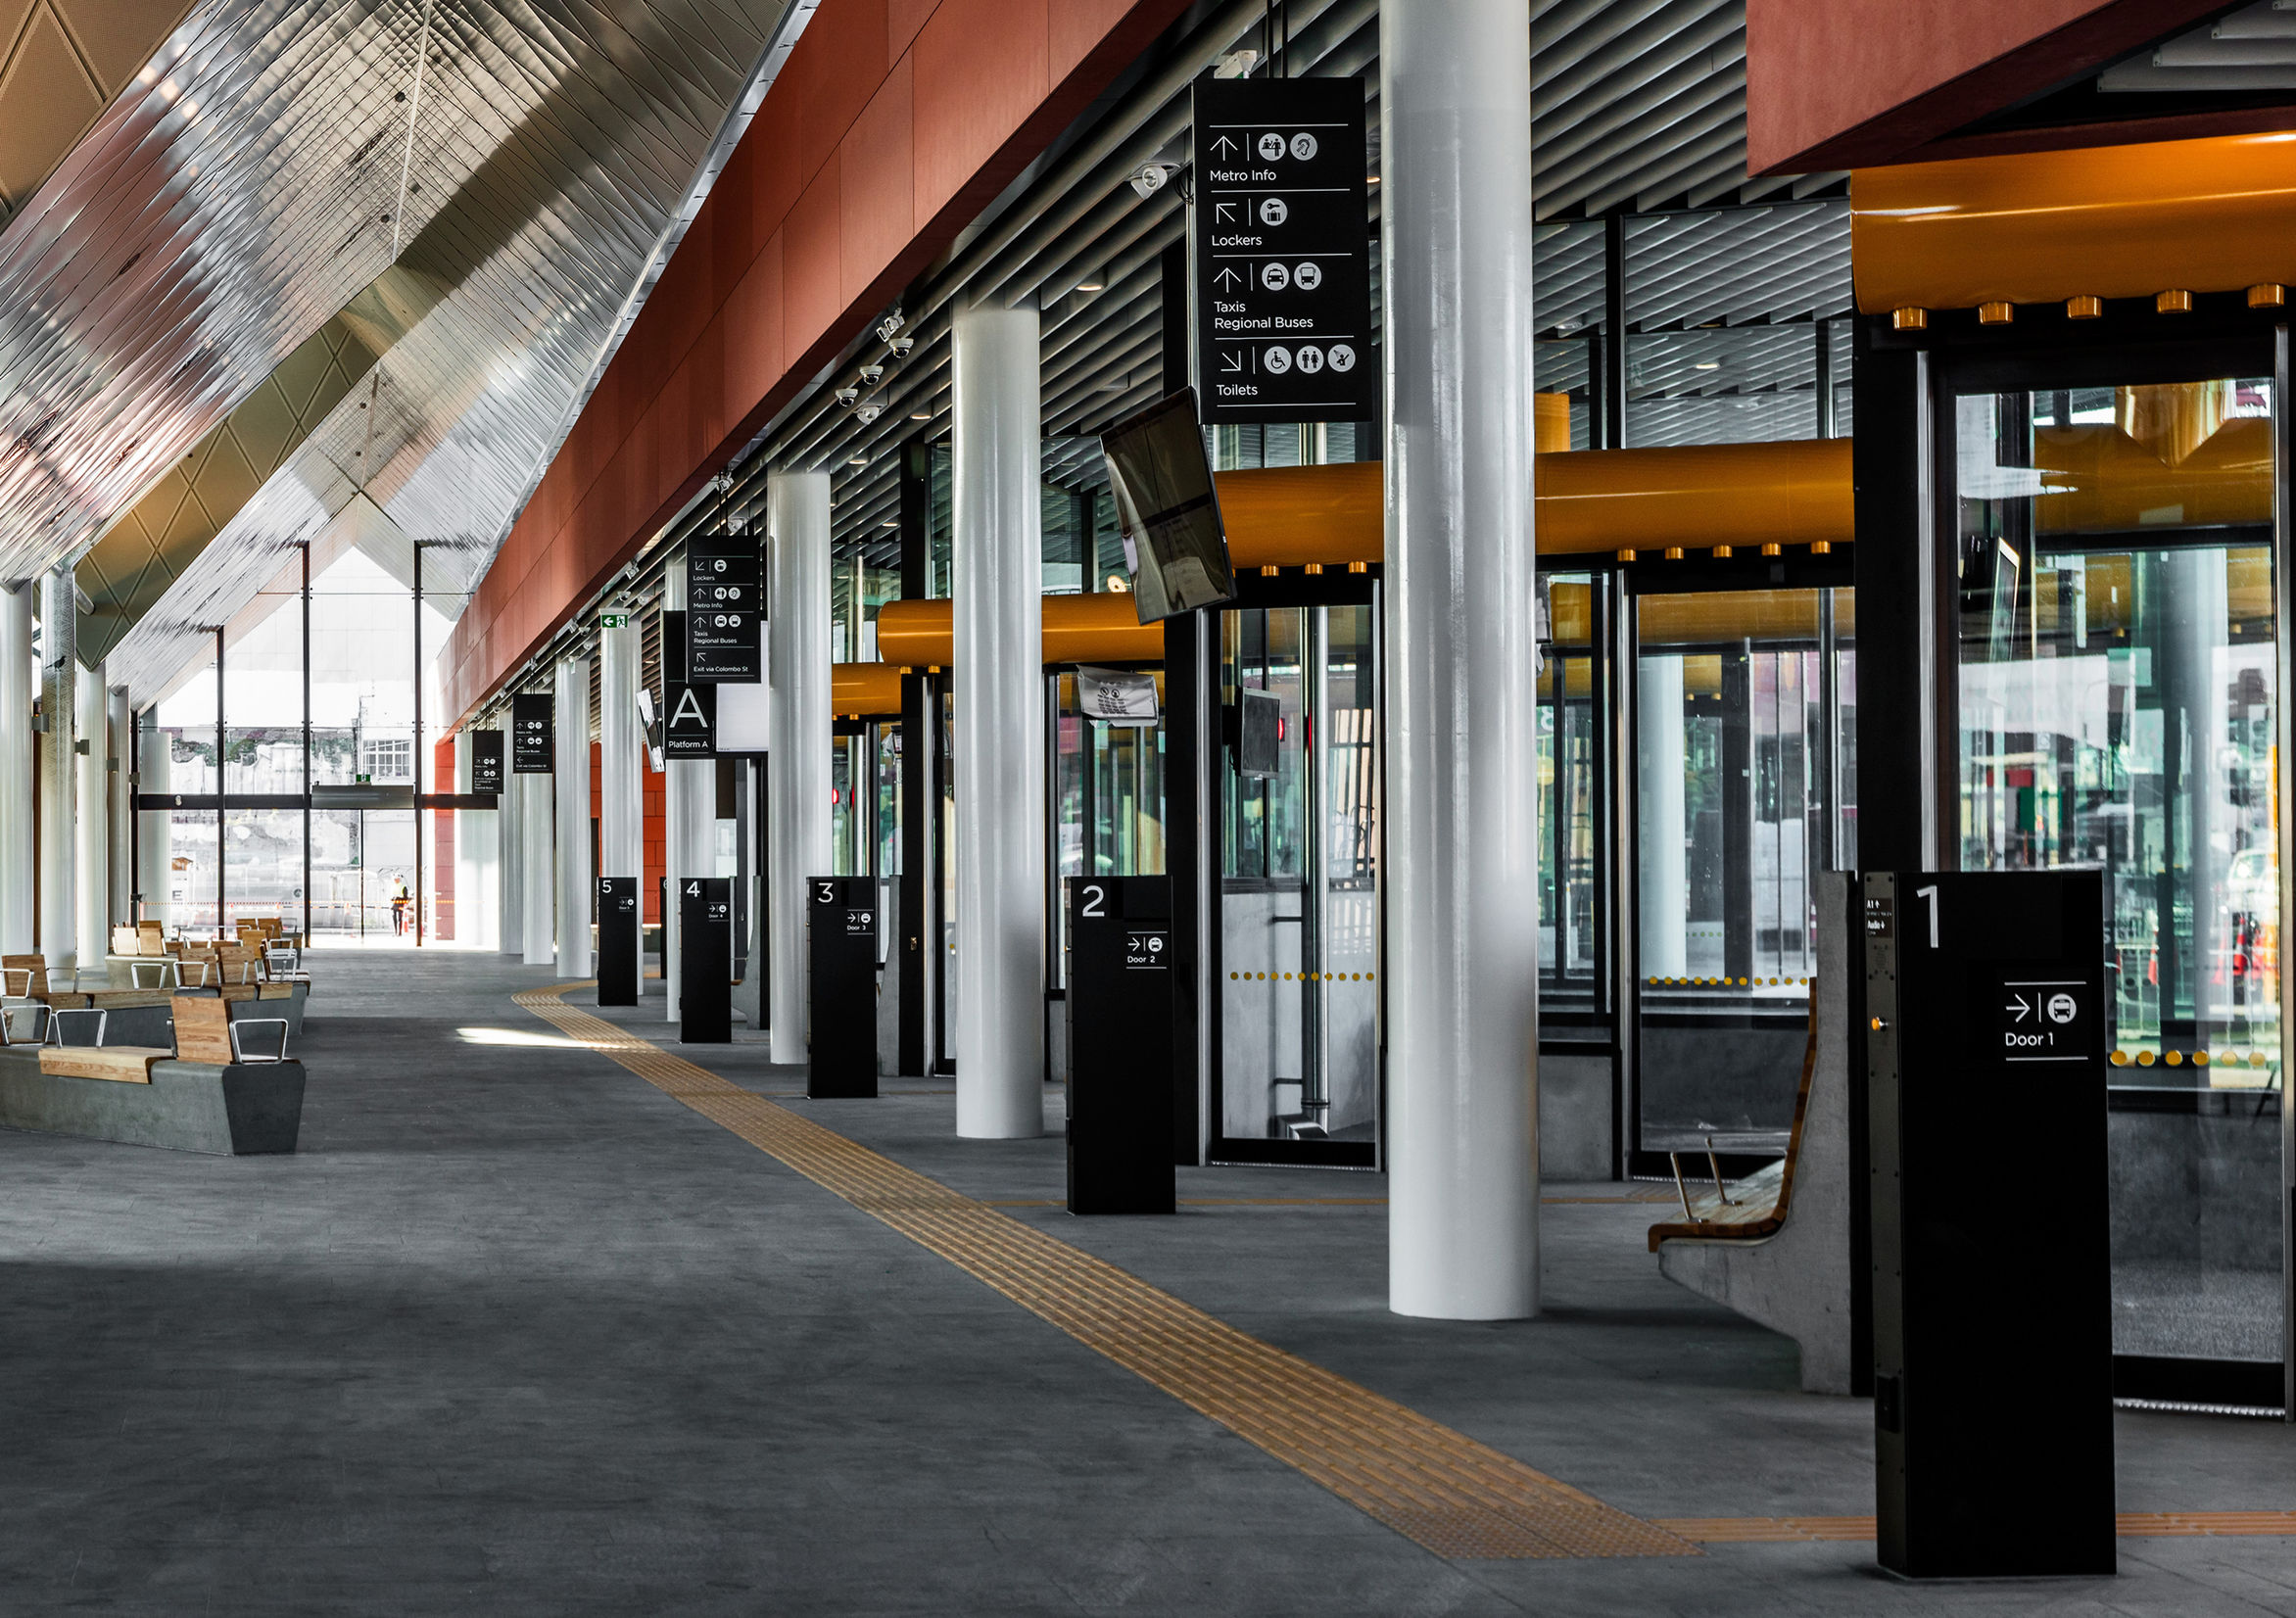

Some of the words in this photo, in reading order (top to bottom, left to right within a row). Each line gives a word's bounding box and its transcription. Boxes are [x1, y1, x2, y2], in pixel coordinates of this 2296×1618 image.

[1210, 169, 1248, 182] Metro
[1252, 169, 1277, 182] Info
[1212, 234, 1263, 247] Lockers
[1214, 301, 1246, 313] Taxis
[1215, 317, 1271, 331] Regional
[1275, 316, 1314, 329] Buses
[1217, 384, 1259, 397] Toilets
[669, 688, 708, 728] A
[602, 880, 612, 893] 5
[687, 880, 700, 897] 4
[818, 882, 834, 903] 3
[1081, 885, 1105, 917] 2
[1916, 885, 1938, 948] 1
[2005, 1031, 2043, 1046] Door
[2047, 1032, 2054, 1046] 1
